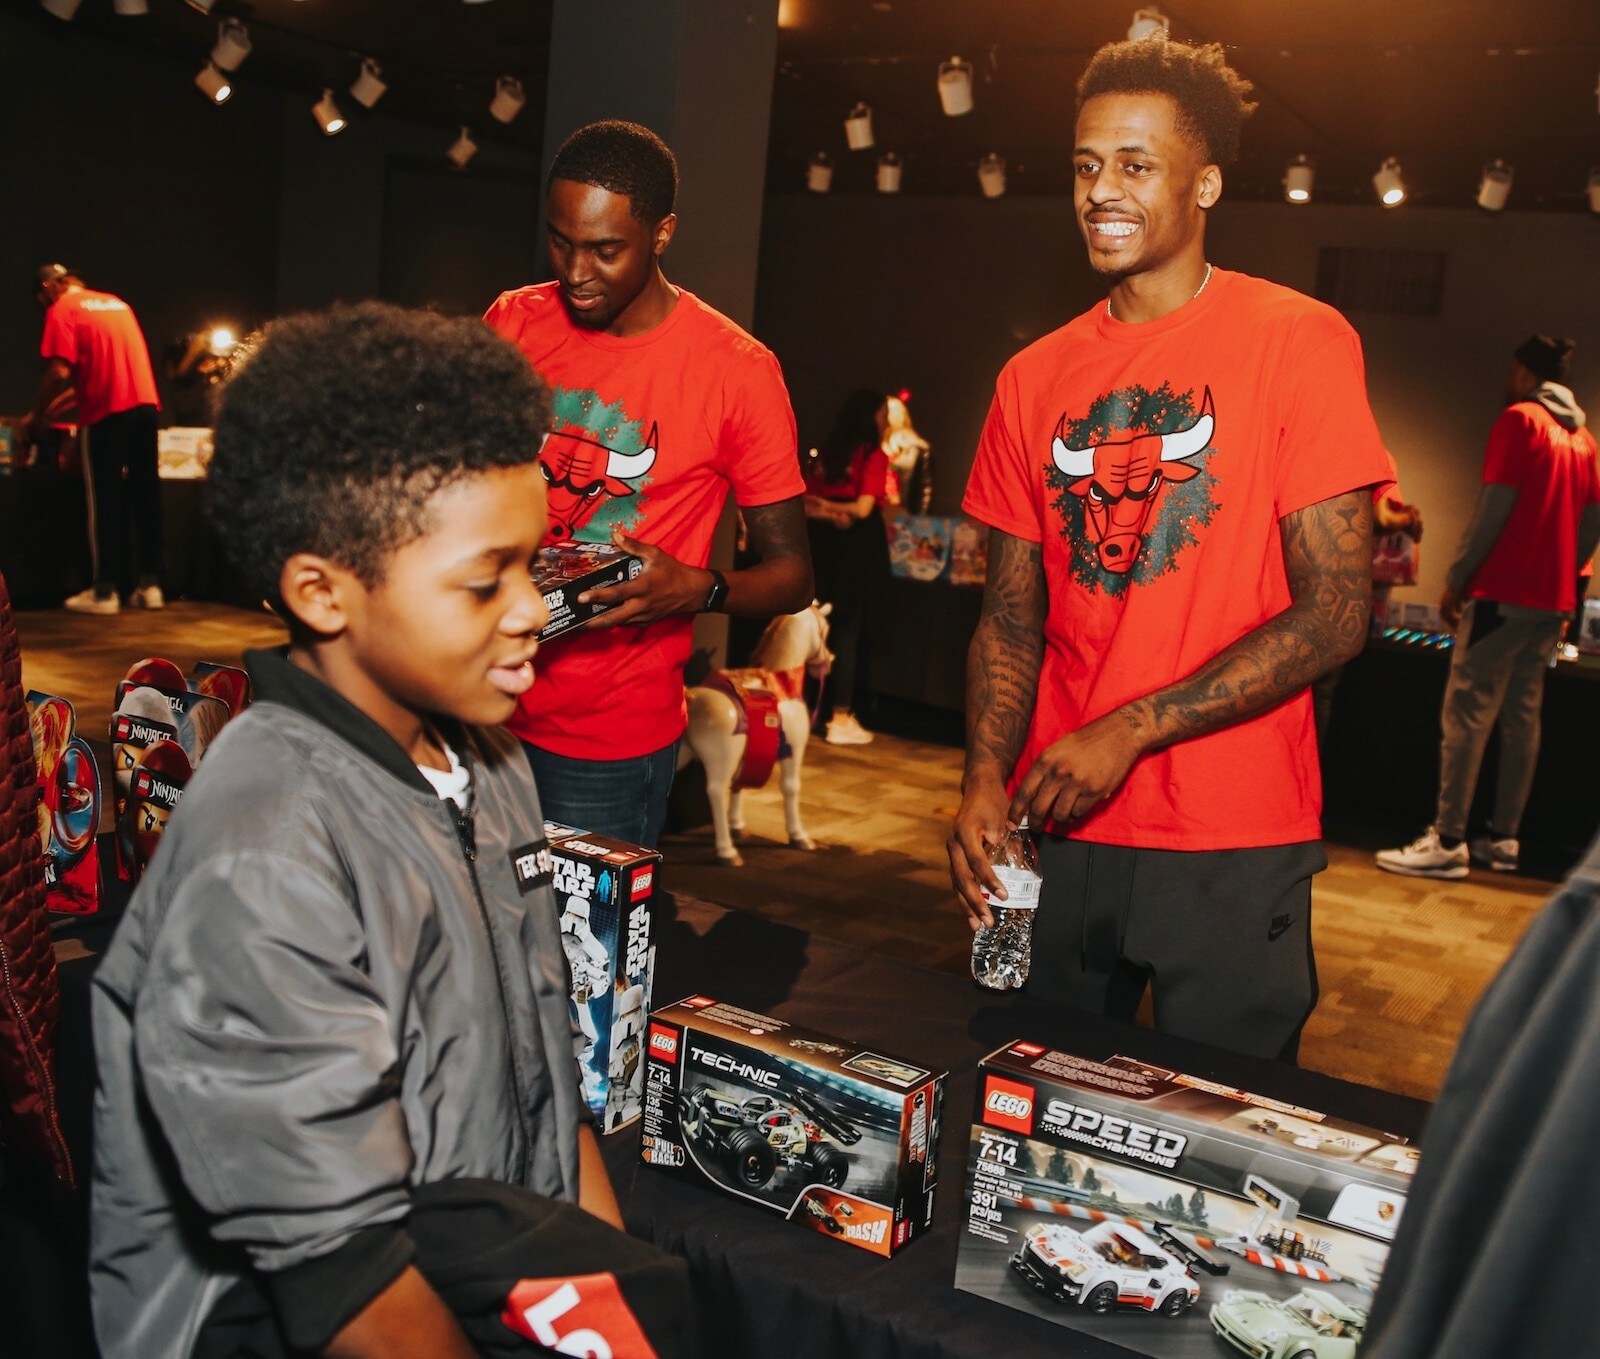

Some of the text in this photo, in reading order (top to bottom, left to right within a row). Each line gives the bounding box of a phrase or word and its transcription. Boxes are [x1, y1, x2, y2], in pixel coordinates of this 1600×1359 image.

[550, 855, 596, 882] TAR
[552, 874, 596, 900] ARS
[632, 872, 653, 893] LEGO
[1271, 914, 1290, 931] NIKE
[625, 906, 641, 979] WARS
[635, 903, 651, 977] STAR
[650, 1031, 677, 1053] LEGO
[648, 1066, 671, 1086] 7-14
[690, 1046, 781, 1087] TECHNIC
[646, 1095, 661, 1108] 135
[987, 1092, 1032, 1119] LEGO
[1043, 1099, 1188, 1159] SPEED
[655, 1136, 675, 1154] PULL
[980, 1138, 1017, 1166] 7-14
[650, 1149, 676, 1167] BACK
[976, 1159, 1006, 1177] 75888
[971, 1190, 998, 1210] 391
[969, 1203, 1003, 1223] pcs/pzs
